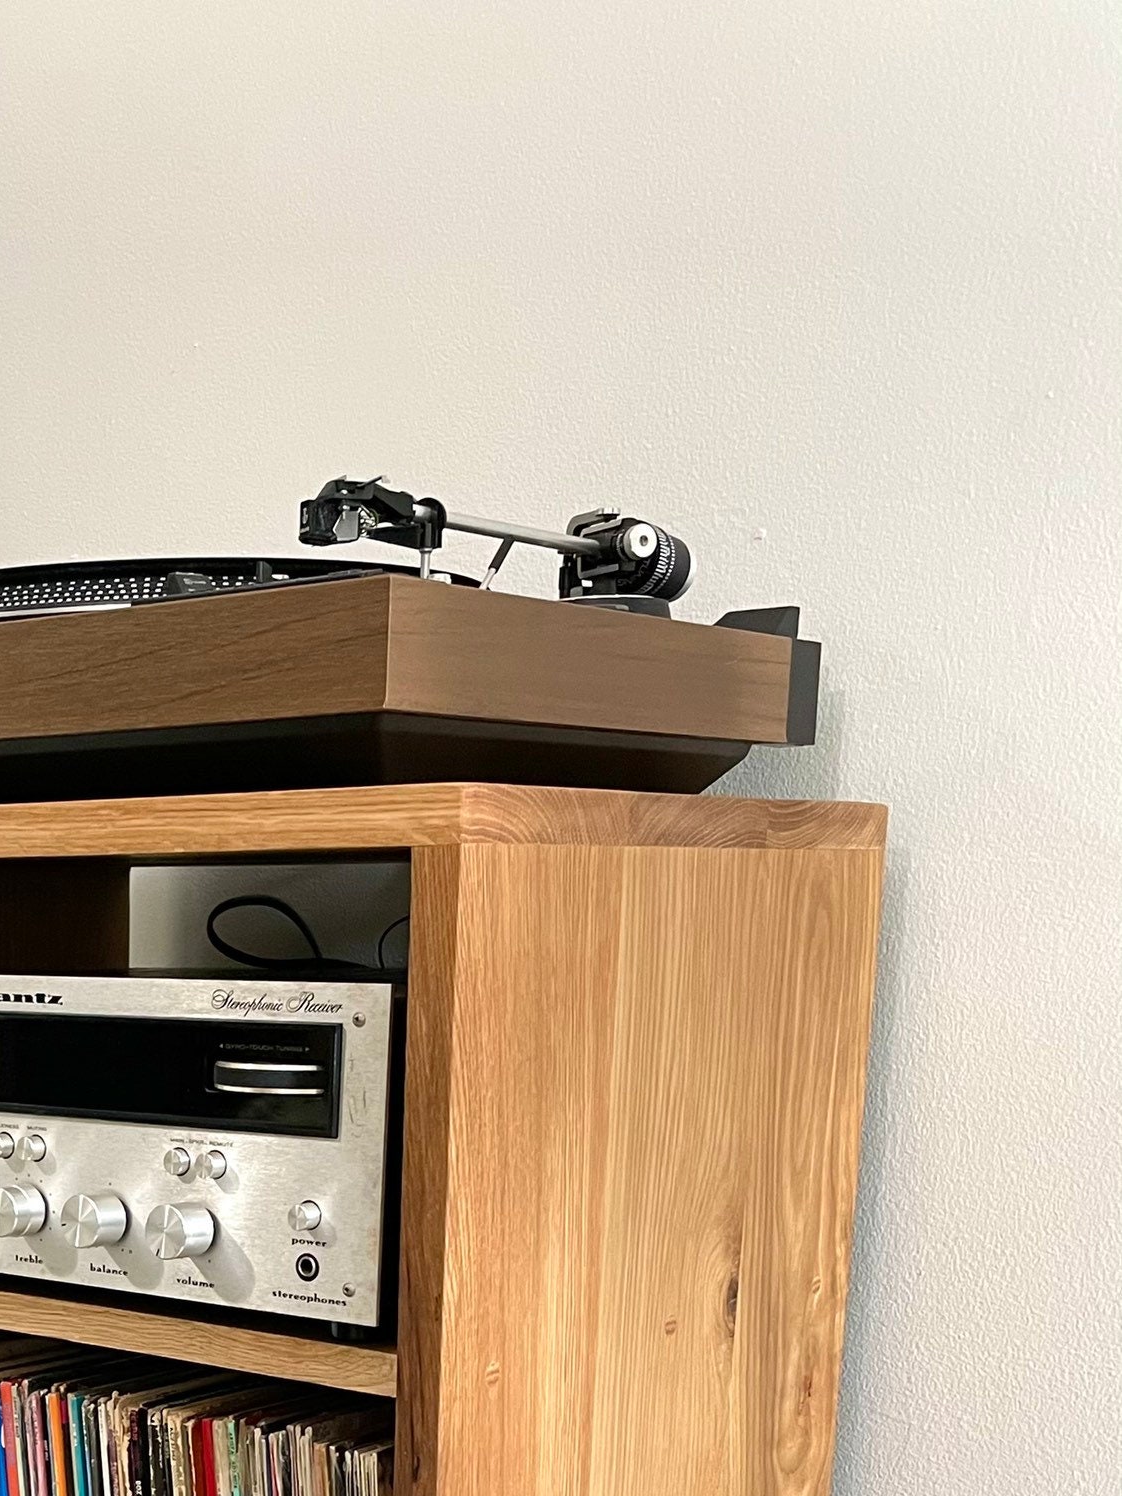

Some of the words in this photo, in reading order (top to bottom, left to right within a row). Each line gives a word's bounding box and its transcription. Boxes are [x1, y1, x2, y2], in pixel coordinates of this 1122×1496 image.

[210, 988, 283, 1017] Stereophonic
[285, 990, 343, 1014] Receiver
[291, 1237, 327, 1248] power
[15, 1254, 43, 1264] treble
[89, 1262, 128, 1277] balance
[176, 1275, 215, 1289] volume
[271, 1289, 347, 1307] stereophones
[134, 1480, 143, 1495] BOZ
